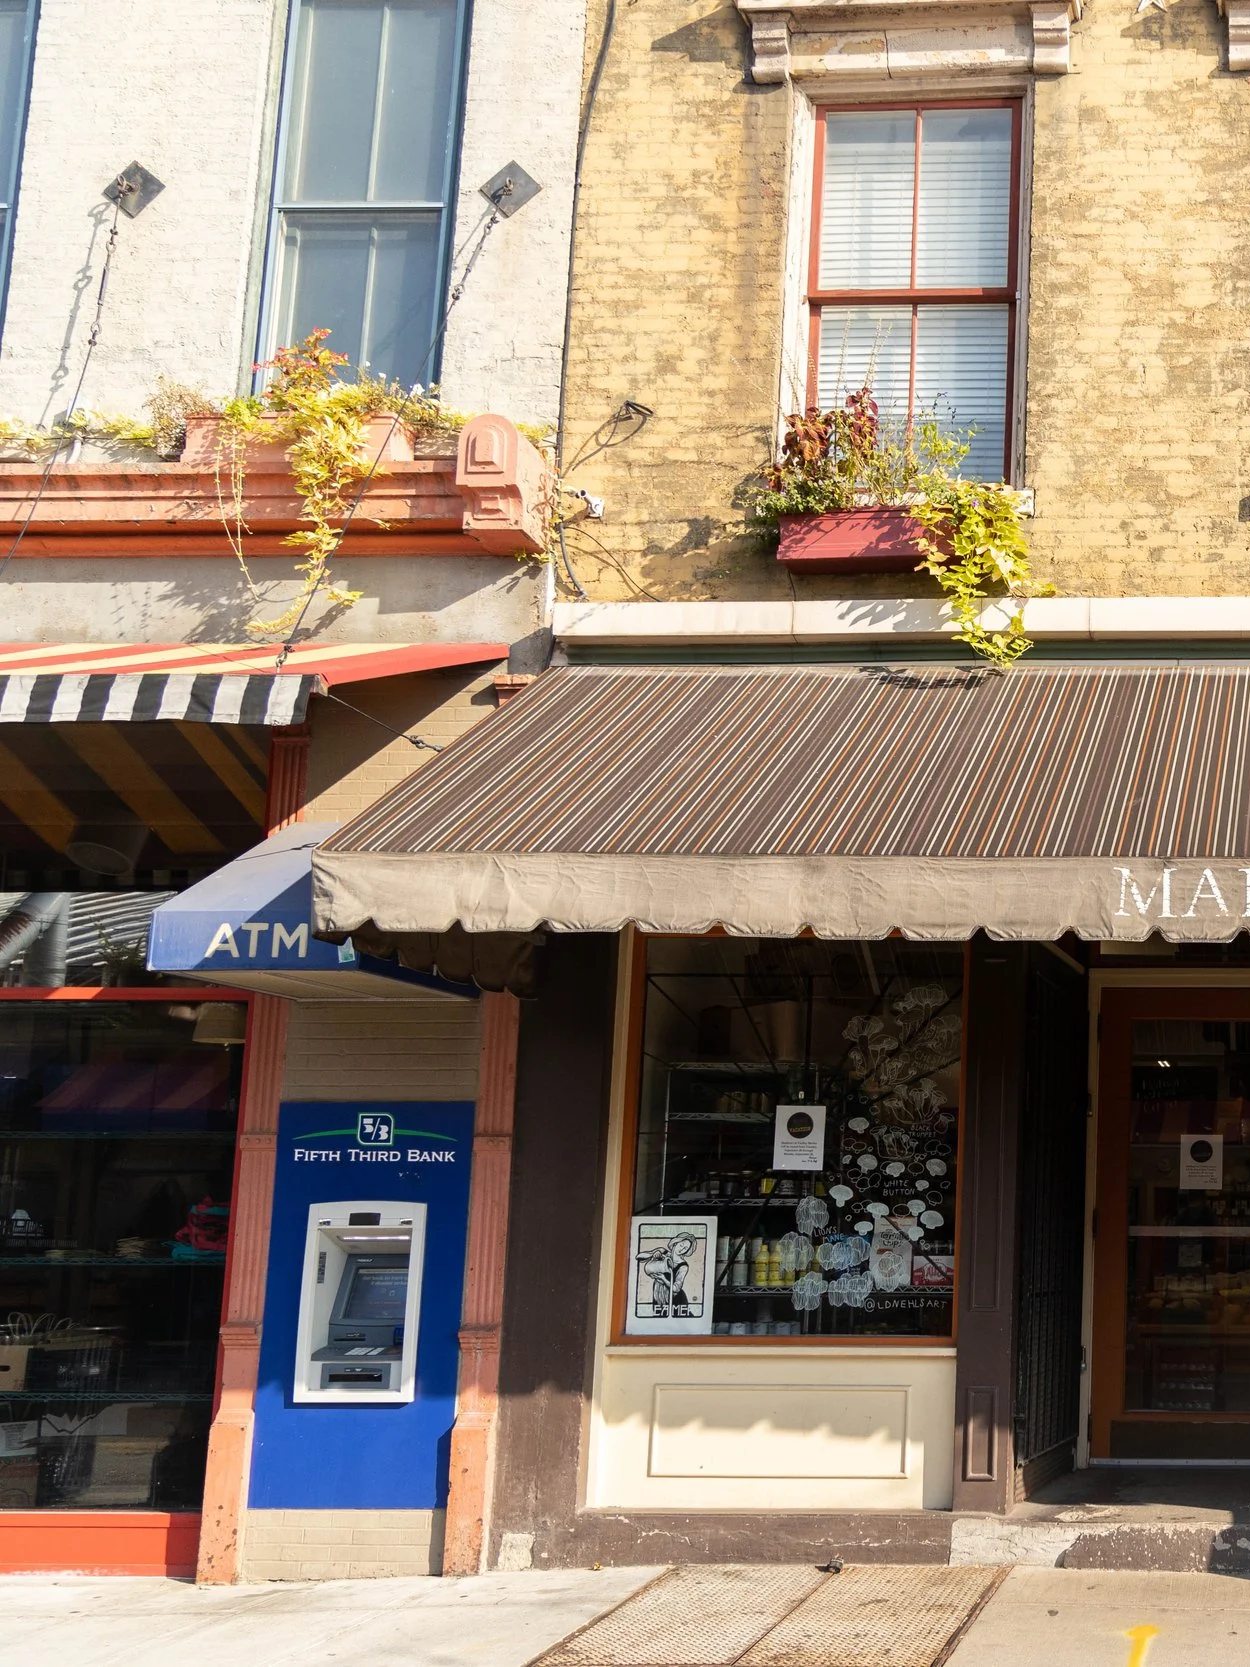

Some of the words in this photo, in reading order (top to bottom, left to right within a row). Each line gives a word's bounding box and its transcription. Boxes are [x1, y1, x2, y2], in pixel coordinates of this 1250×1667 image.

[204, 922, 309, 958] ATM
[294, 1149, 341, 1162] FIFTH
[347, 1149, 401, 1162] THIRD
[407, 1149, 456, 1163] BANK
[884, 1179, 909, 1188] WHITE
[883, 1187, 915, 1197] BUTTON
[822, 1233, 845, 1244] MANE
